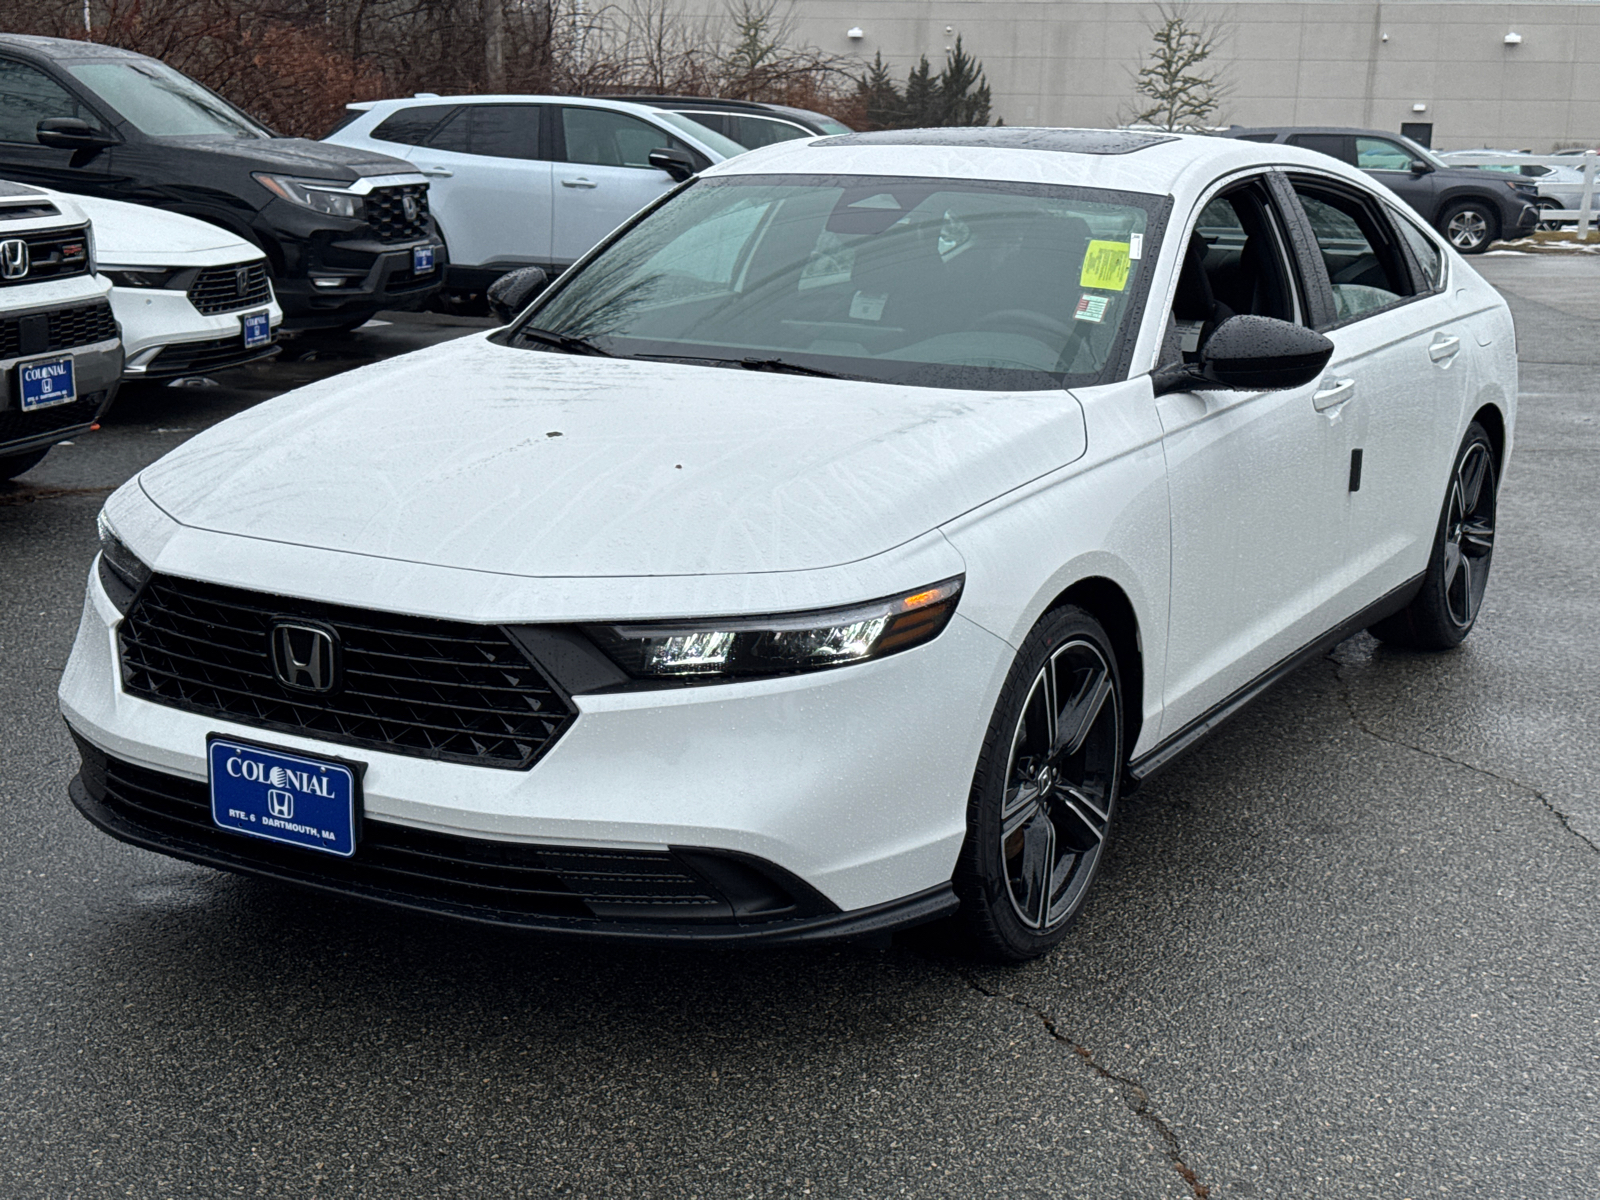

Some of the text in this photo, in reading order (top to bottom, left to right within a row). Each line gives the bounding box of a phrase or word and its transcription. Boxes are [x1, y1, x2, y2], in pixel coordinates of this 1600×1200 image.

[25, 364, 67, 382] COLONIAL
[226, 756, 336, 799] COLONIAL
[228, 808, 336, 841] RTE. 6 DARTMOUTH, MA
